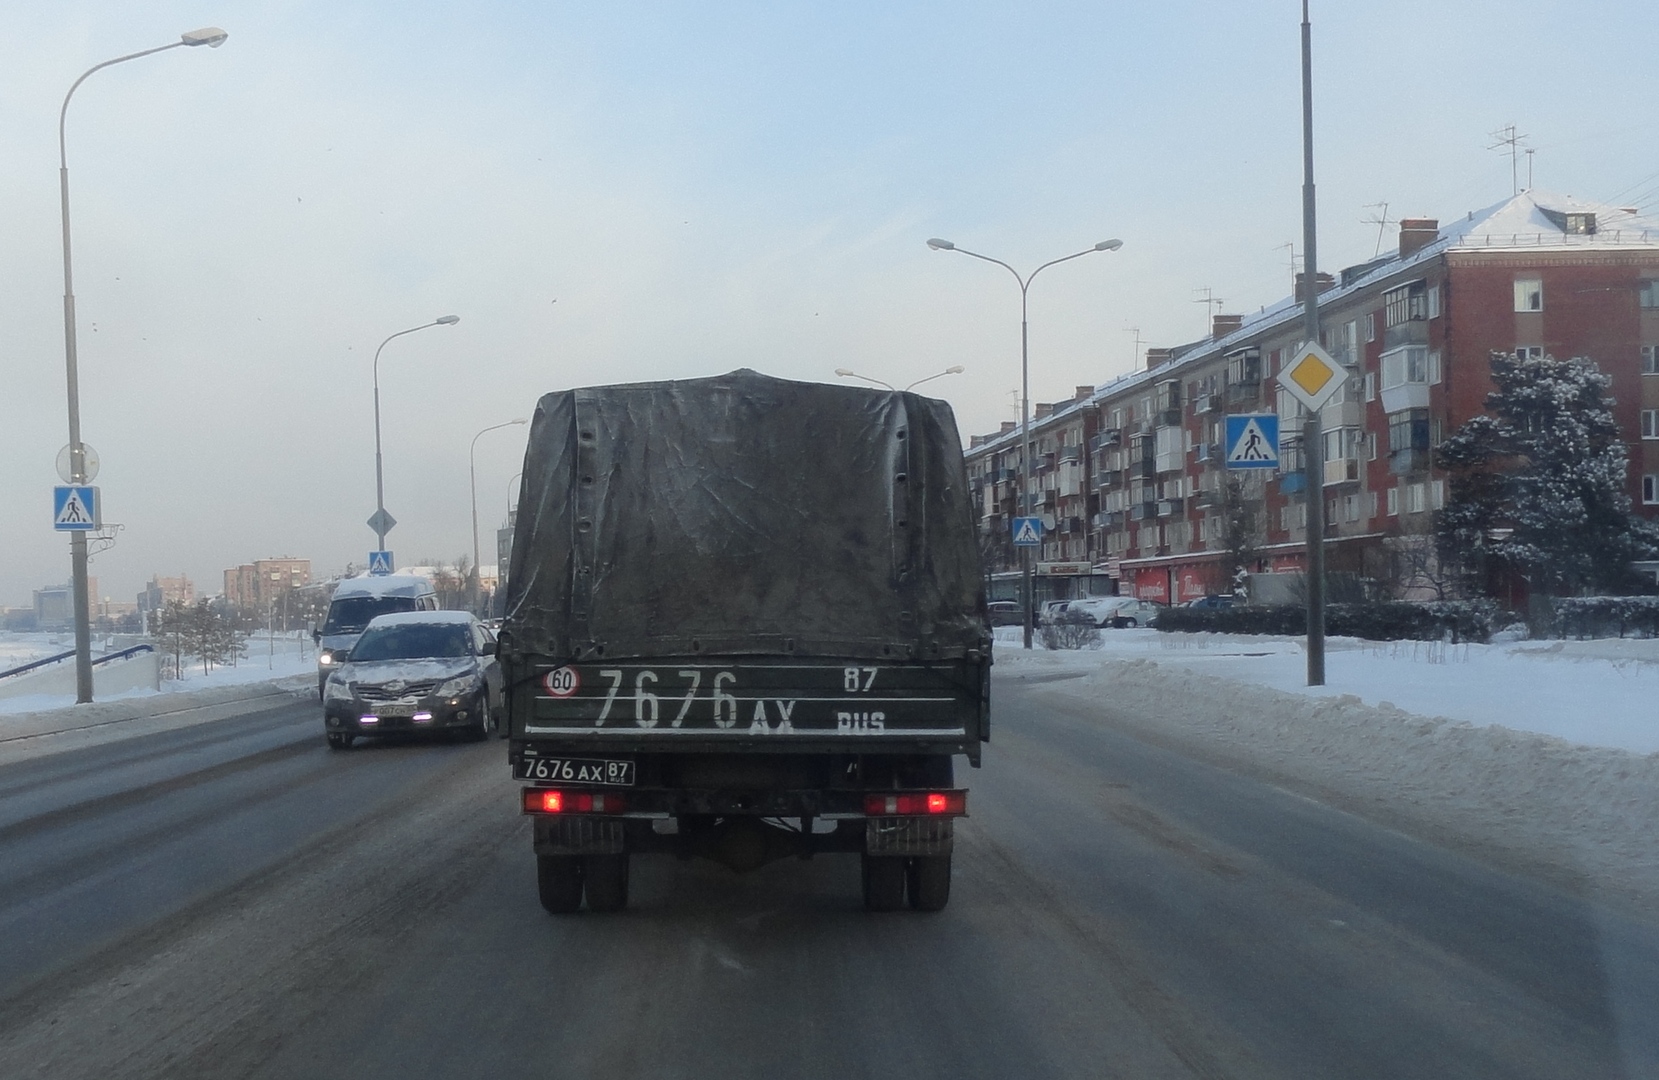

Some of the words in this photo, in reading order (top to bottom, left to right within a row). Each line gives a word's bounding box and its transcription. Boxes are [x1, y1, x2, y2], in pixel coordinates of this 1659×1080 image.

[552, 667, 572, 690] 60
[844, 667, 878, 692] 87
[595, 670, 737, 728] 7676
[750, 700, 796, 735] AX
[523, 758, 574, 779] 7676
[577, 765, 603, 781] AX
[608, 762, 628, 777] 87
